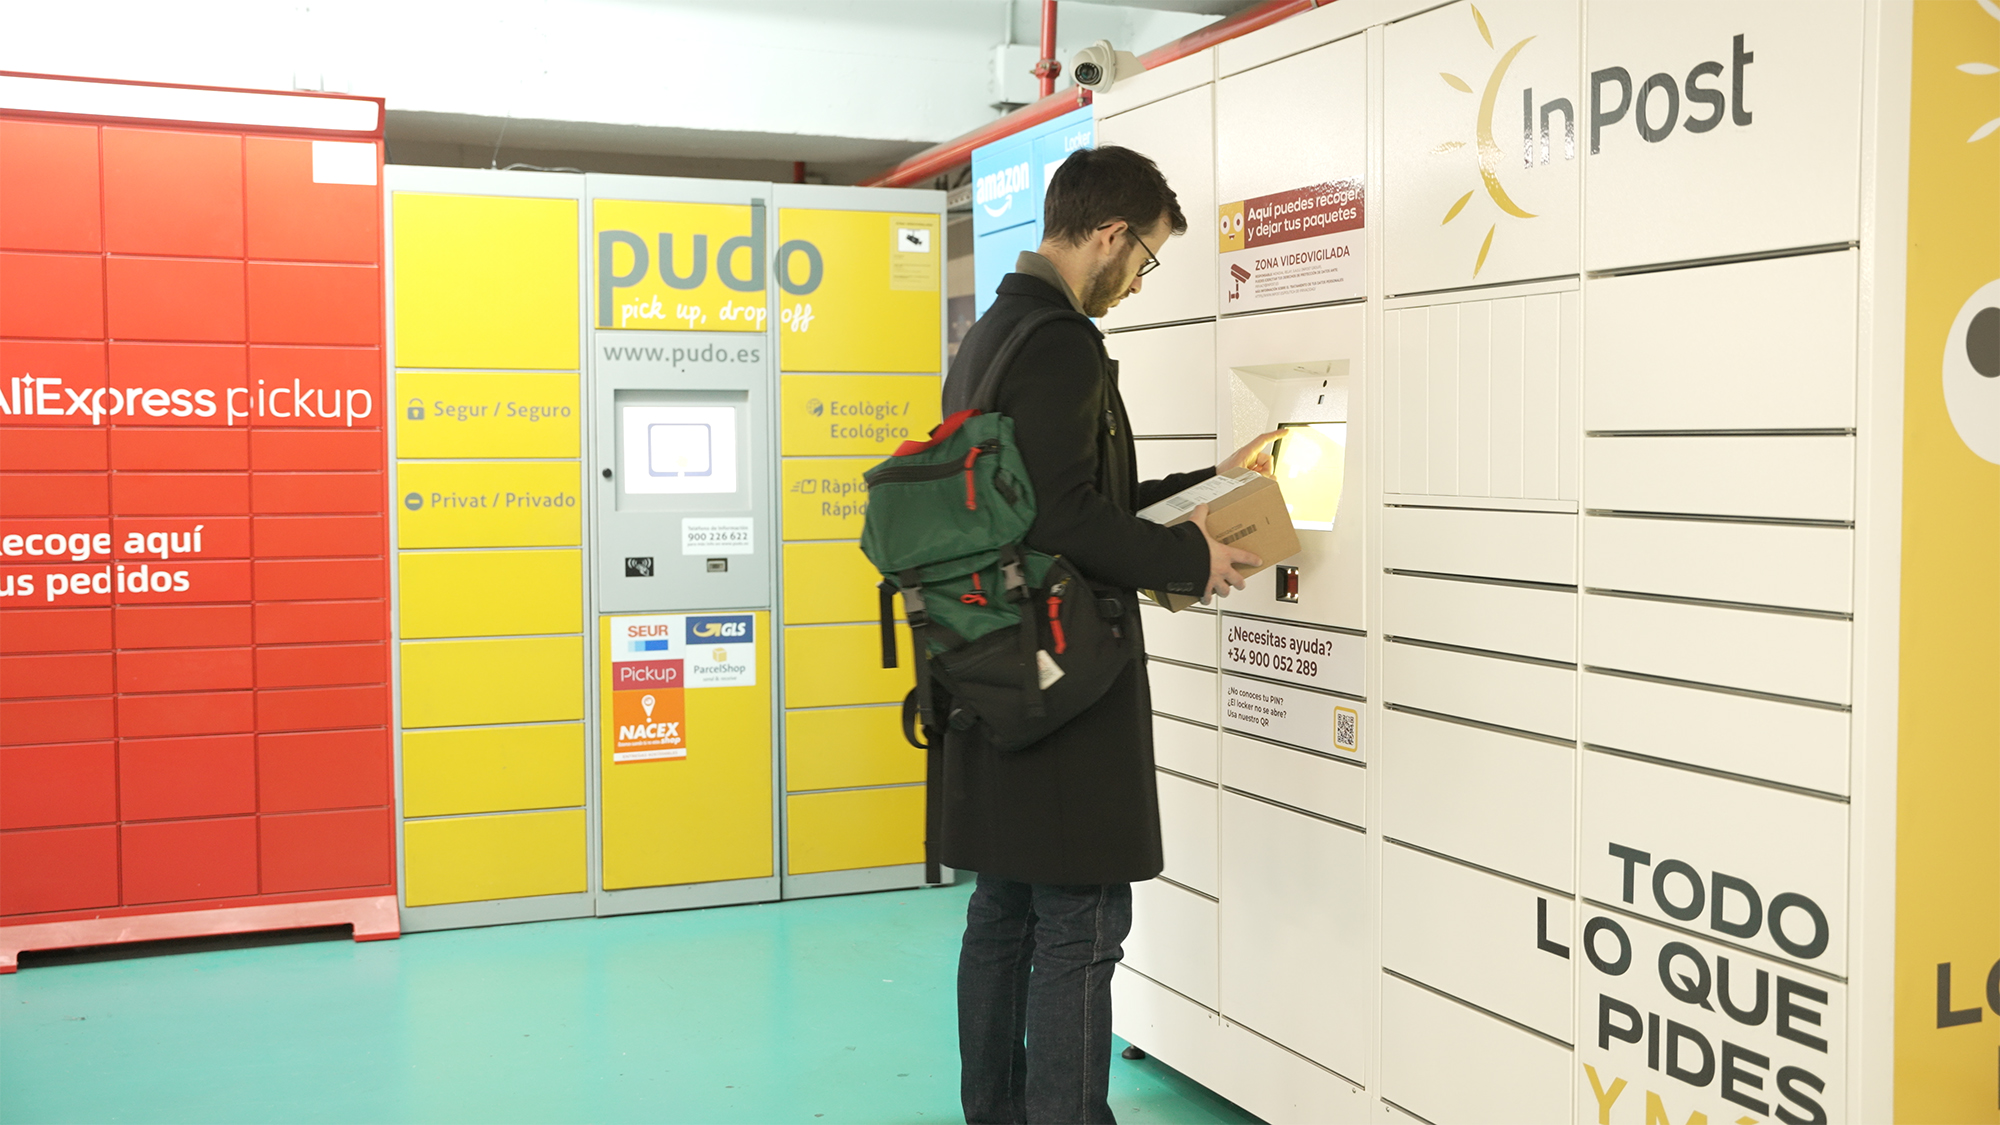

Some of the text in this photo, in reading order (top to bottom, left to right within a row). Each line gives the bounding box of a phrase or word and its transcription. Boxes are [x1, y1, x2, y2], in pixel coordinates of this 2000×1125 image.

[1523, 33, 1754, 169] InPost
[1064, 131, 1091, 152] Locker
[976, 162, 1029, 204] amazon
[1247, 188, 1360, 221] Aquí puedes recoger
[1247, 207, 1357, 241] y dejar tus paquetes
[598, 198, 824, 327] pudo
[1255, 245, 1350, 271] ZONA VIDEOVIGILADA
[621, 294, 815, 332] pick up, drop off
[603, 343, 761, 368] www.pudo.es
[227, 378, 373, 427] pickup
[434, 401, 488, 422] Segur
[506, 401, 571, 422] Seguro
[831, 401, 898, 421] Ecològic
[831, 423, 909, 443] Ecológico
[431, 492, 488, 508] Privat
[506, 492, 576, 508] Privado
[0, 524, 204, 561] ecoge aquí
[688, 531, 748, 542] 900 226 622
[46, 564, 190, 602] pedidos
[627, 624, 669, 638] SEUR
[721, 622, 746, 637] GLS
[1227, 626, 1333, 656] ¿Necesitas ayuda?
[620, 666, 677, 683] Pickup
[694, 663, 746, 675] ParcelShop
[1228, 647, 1318, 677] +34 900 052 289
[1227, 687, 1284, 706] ¿No conoces tu PIN?
[1227, 698, 1287, 719] ¿El locker no se abre?
[1227, 709, 1269, 727] Usa nuestro QR
[619, 722, 679, 740] NACEX
[661, 736, 681, 745] shop
[1609, 842, 1829, 960] TODO
[1537, 896, 1828, 1054] LO QUE
[1937, 958, 2000, 1029] L
[1598, 993, 1828, 1125] PIDES
